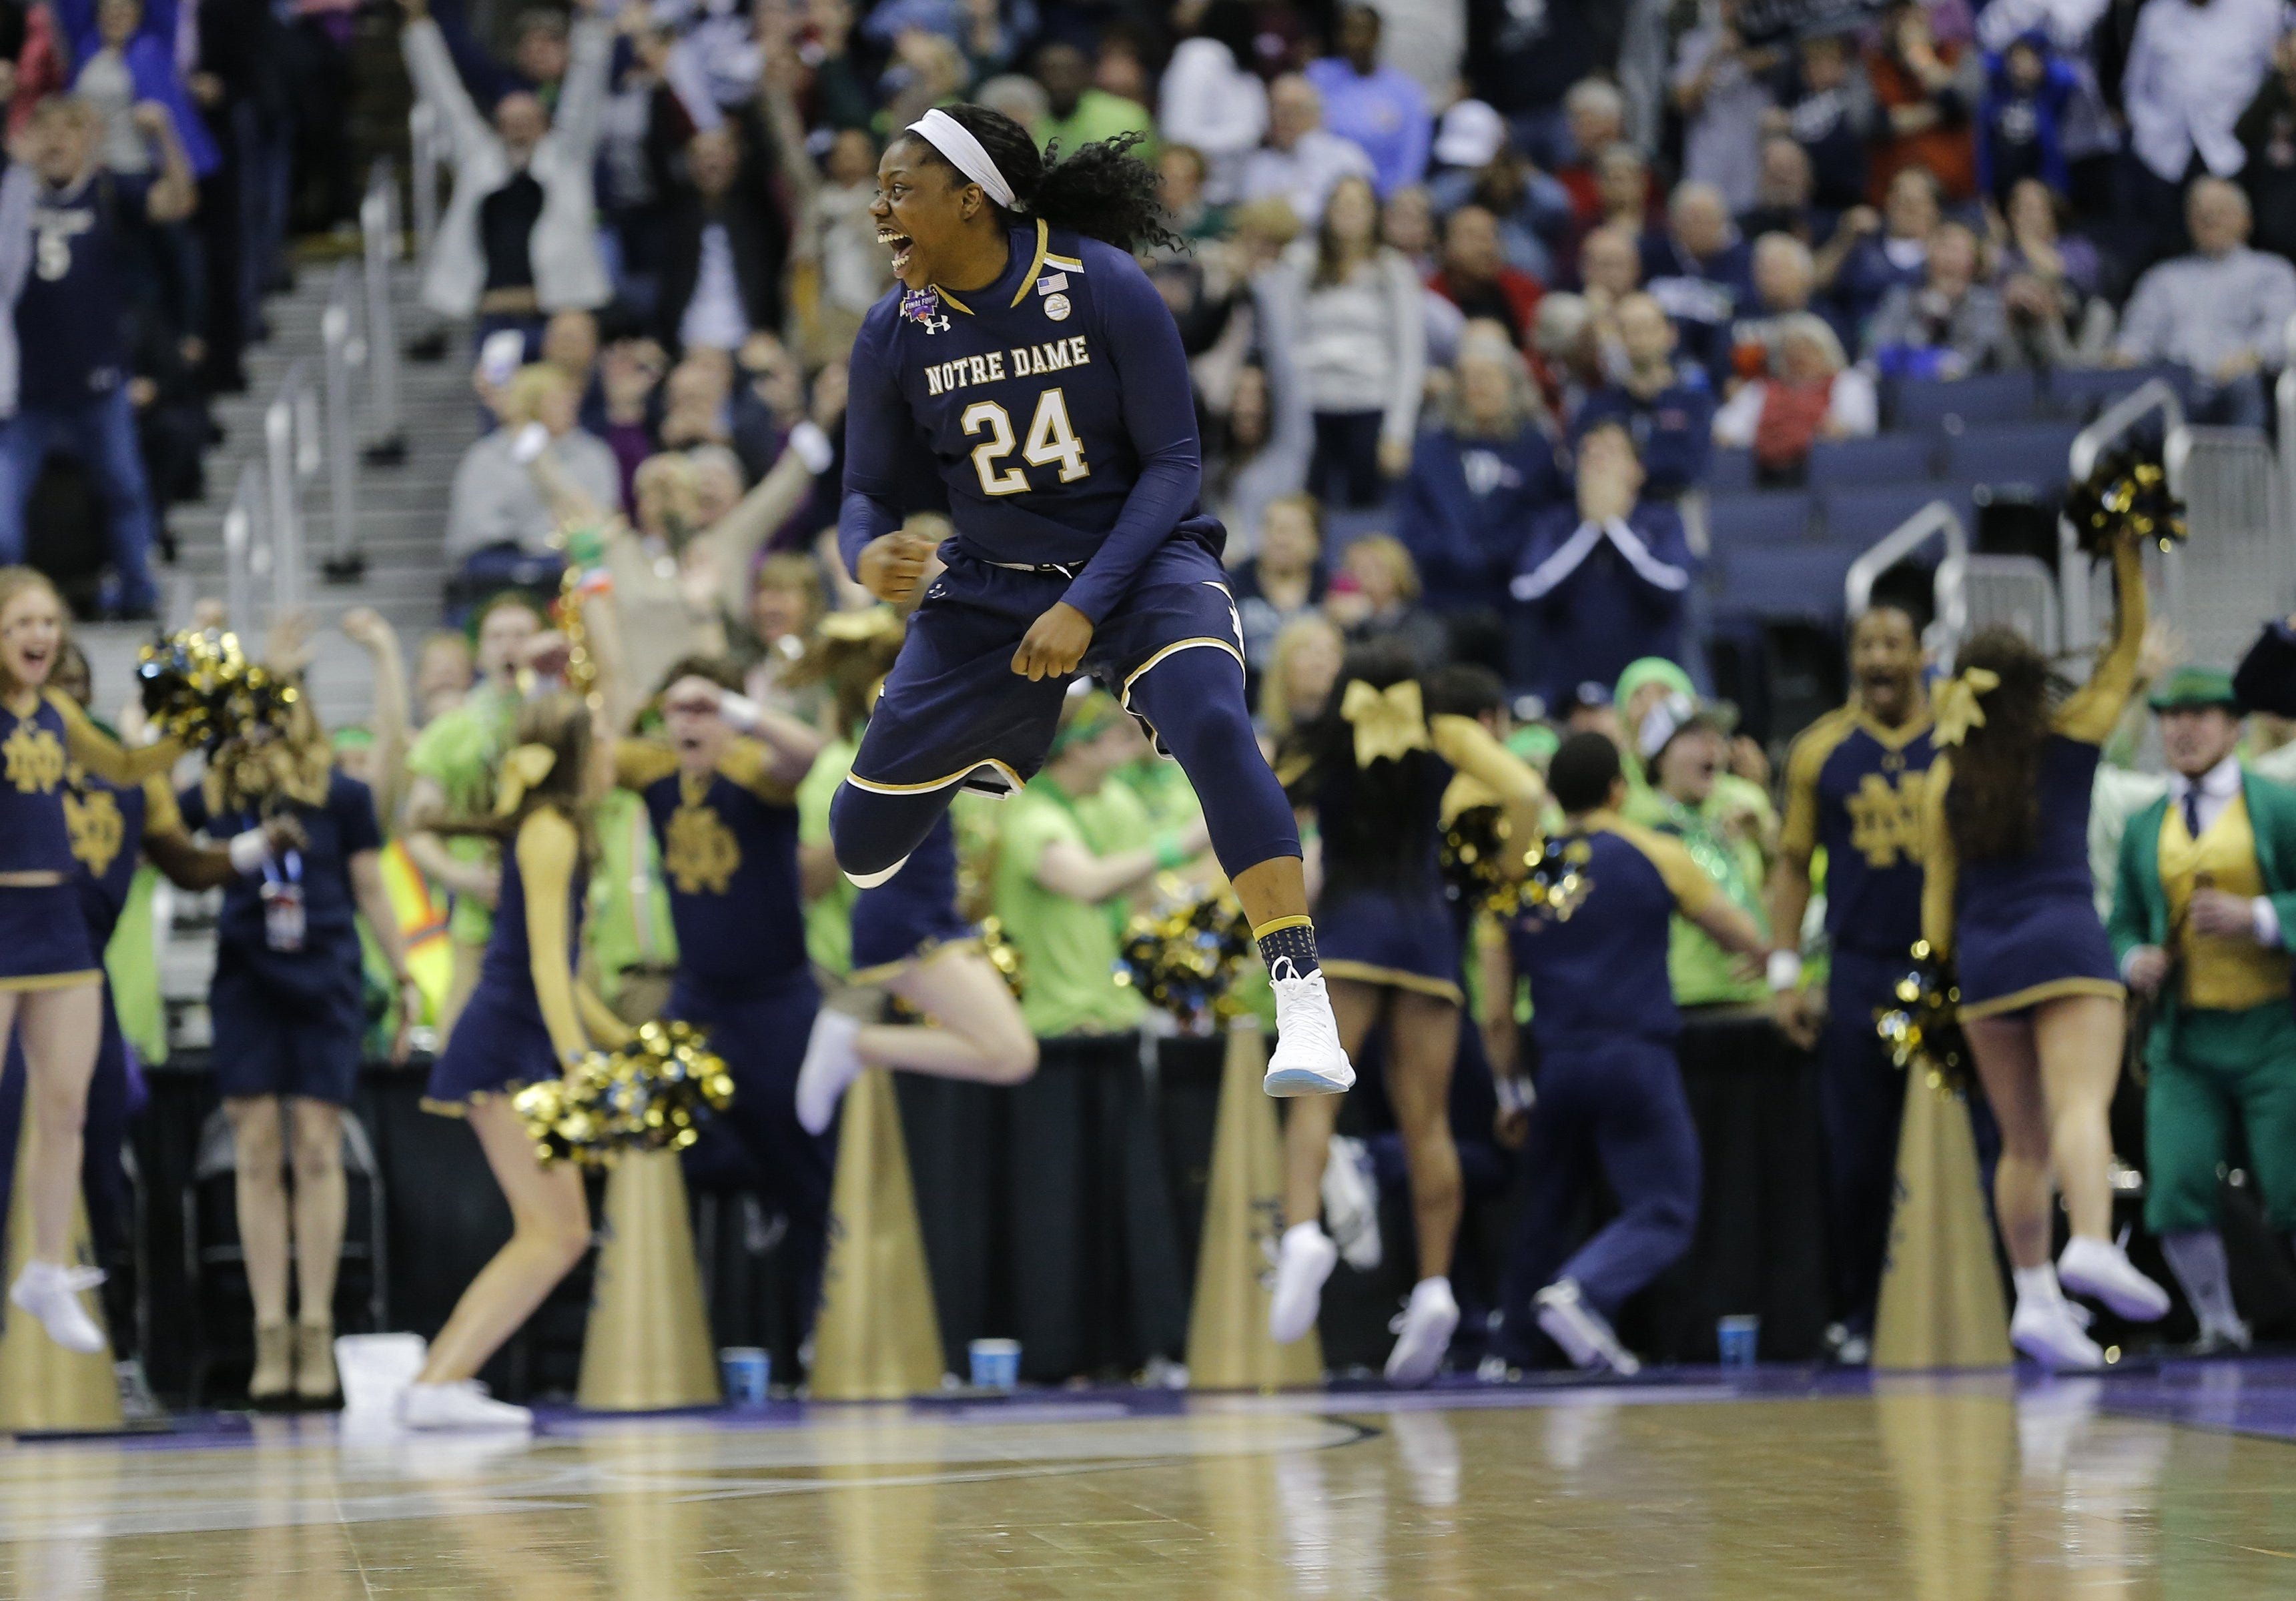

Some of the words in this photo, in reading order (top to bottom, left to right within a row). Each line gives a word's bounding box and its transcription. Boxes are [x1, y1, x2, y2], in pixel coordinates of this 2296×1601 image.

[905, 300, 921, 310] FINAL
[925, 351, 1006, 396] NOTRE
[1010, 336, 1090, 378] DAME
[960, 388, 1090, 495] 24
